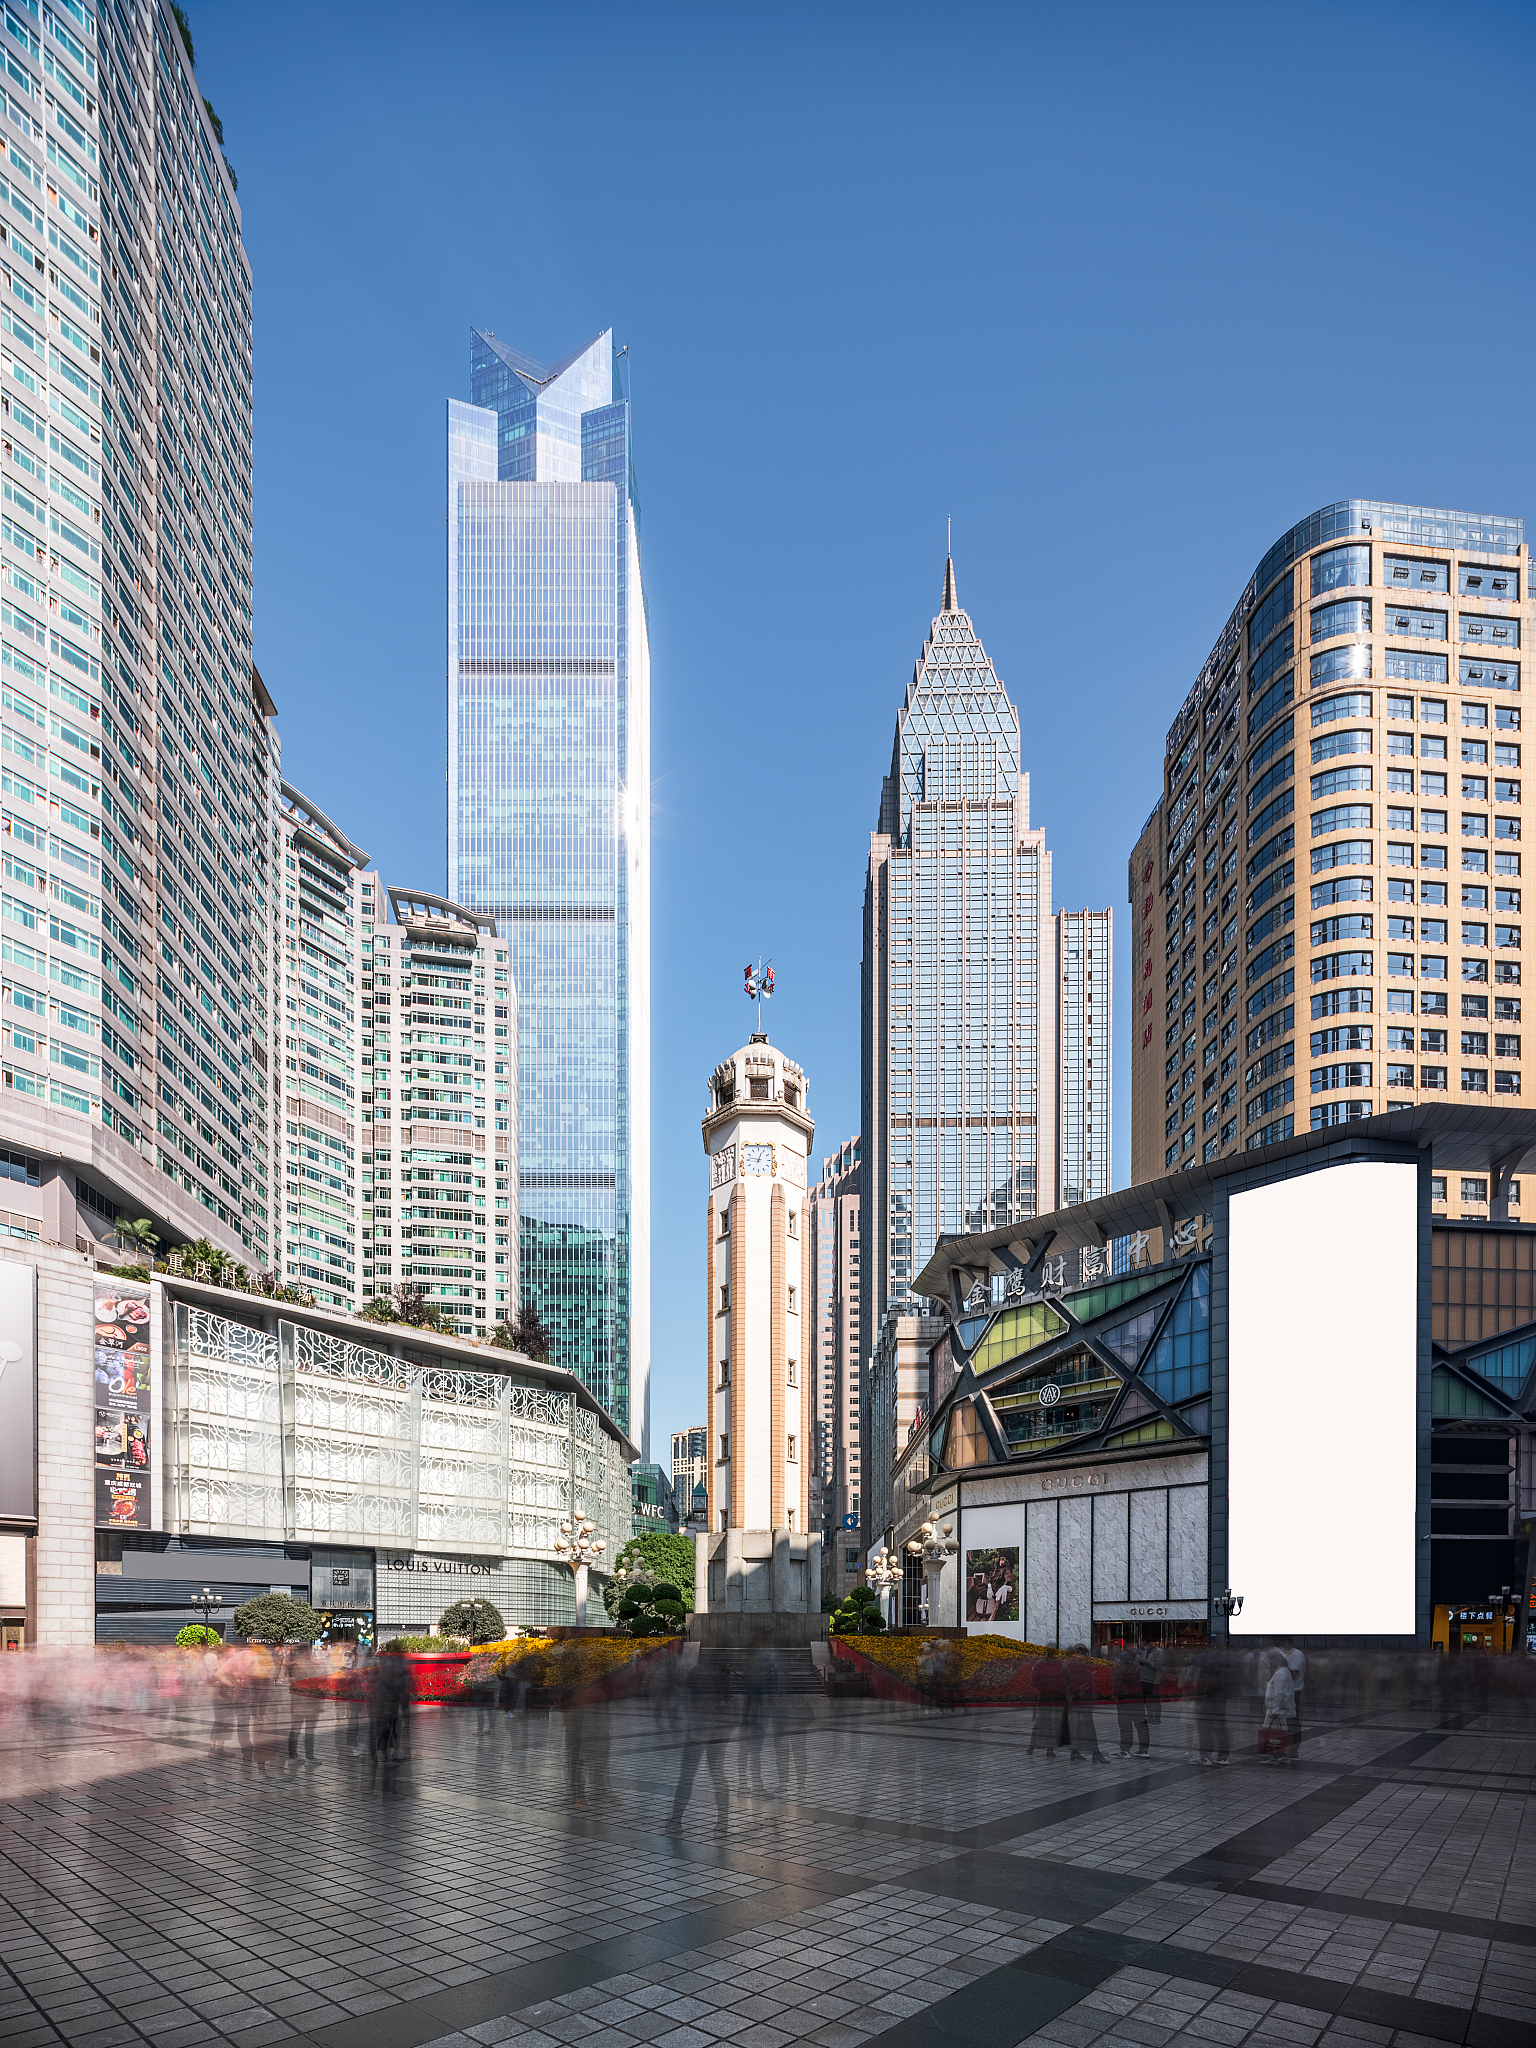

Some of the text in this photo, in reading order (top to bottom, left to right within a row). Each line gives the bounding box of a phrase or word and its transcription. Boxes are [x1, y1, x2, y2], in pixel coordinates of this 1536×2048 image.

[965, 1223, 1199, 1306] 金鹰财富中心
[1041, 1472, 1109, 1491] GUCCI
[935, 1493, 954, 1510] GUCCI
[387, 1559, 491, 1575] LOUIS VUITTON
